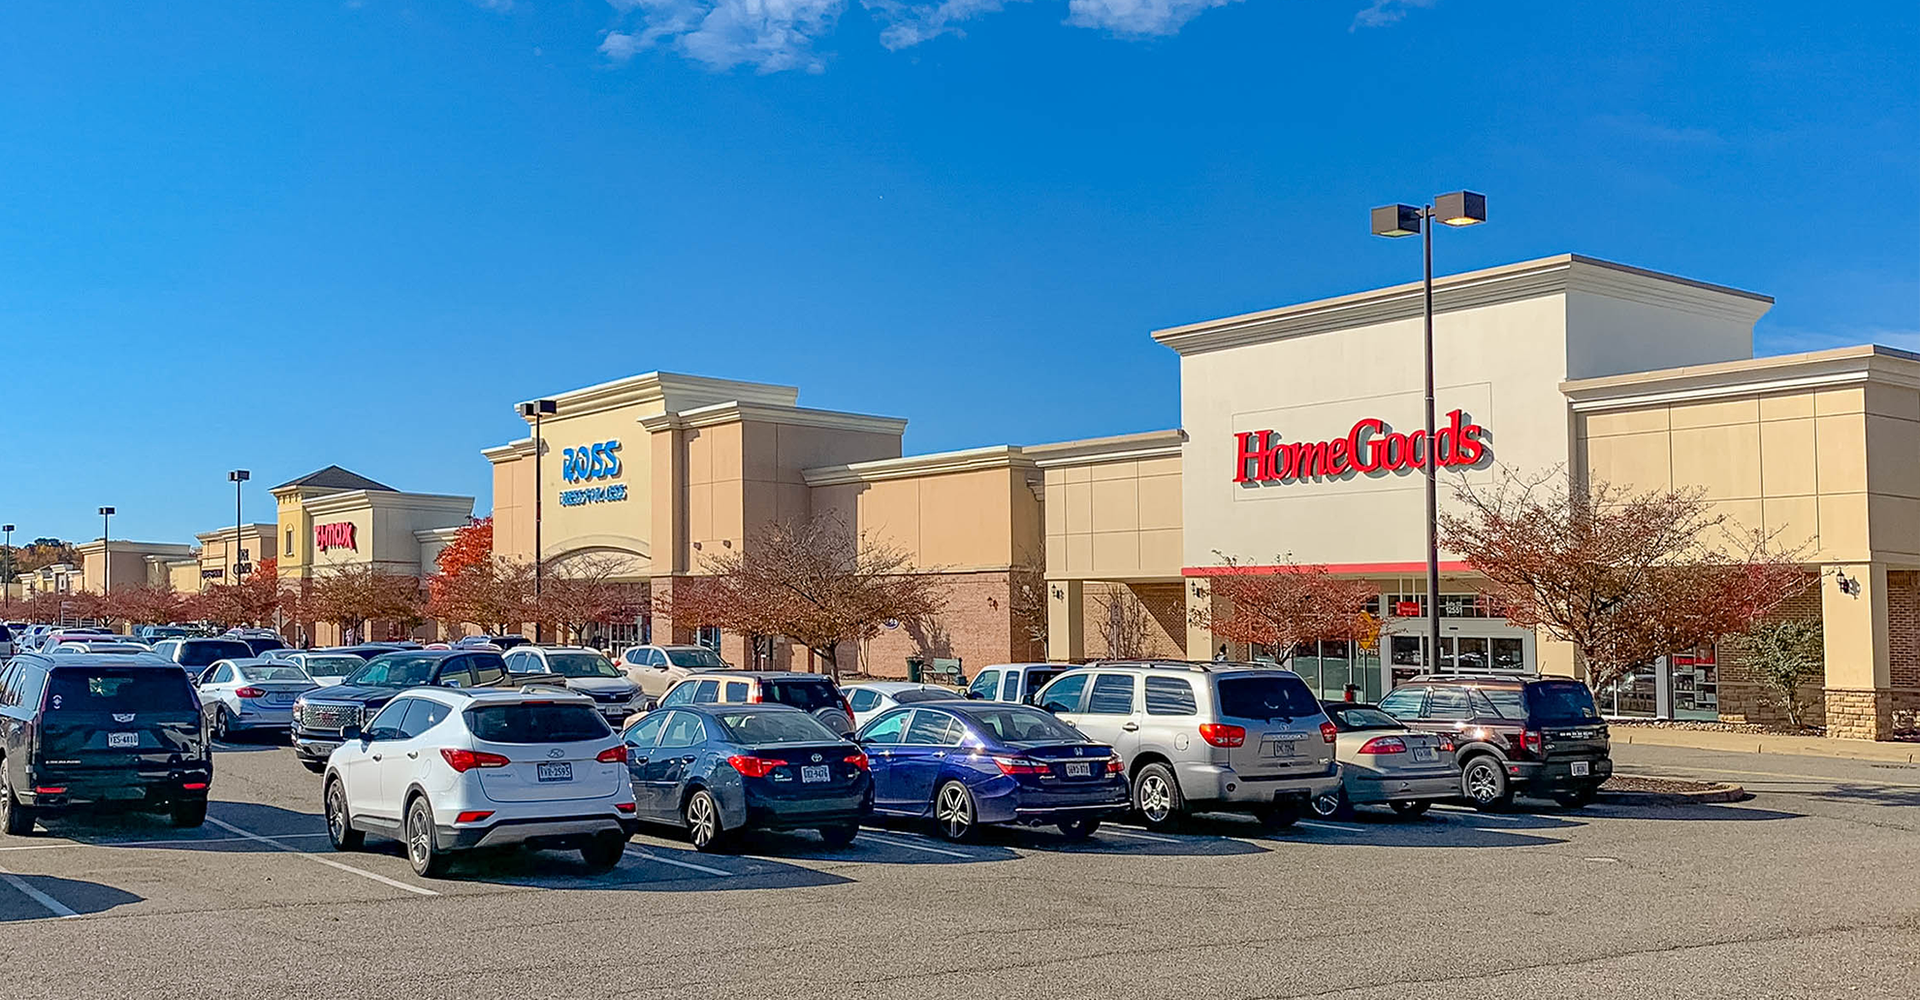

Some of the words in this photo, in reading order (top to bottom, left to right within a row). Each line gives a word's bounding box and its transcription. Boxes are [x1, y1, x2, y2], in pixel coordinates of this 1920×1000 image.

[563, 440, 619, 481] ROSS
[1233, 409, 1484, 483] HomeGoods
[1358, 647, 1379, 656] GFTS
